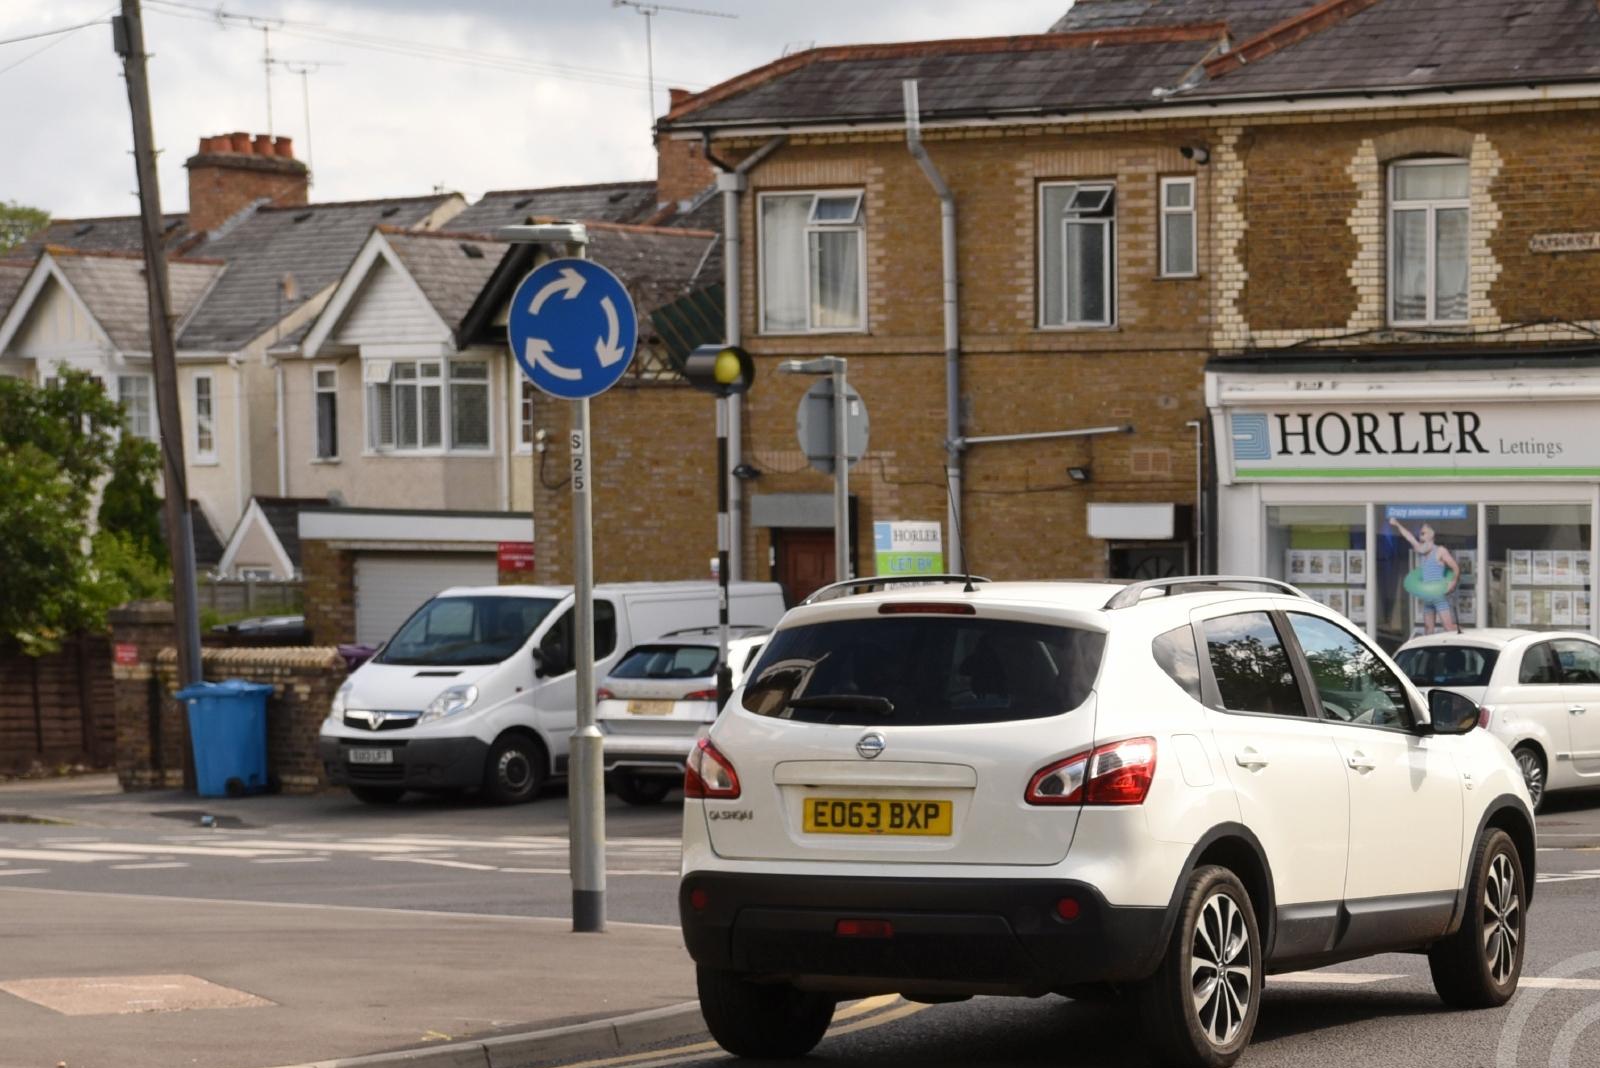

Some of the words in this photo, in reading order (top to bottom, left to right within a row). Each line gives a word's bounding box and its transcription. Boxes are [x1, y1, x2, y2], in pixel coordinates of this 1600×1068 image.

[1274, 411, 1490, 456] HORLER
[1499, 437, 1563, 459] Lettings
[894, 528, 938, 542] HORLER
[890, 556, 912, 571] LET
[813, 801, 881, 828] EO63
[889, 802, 940, 830] BXP
